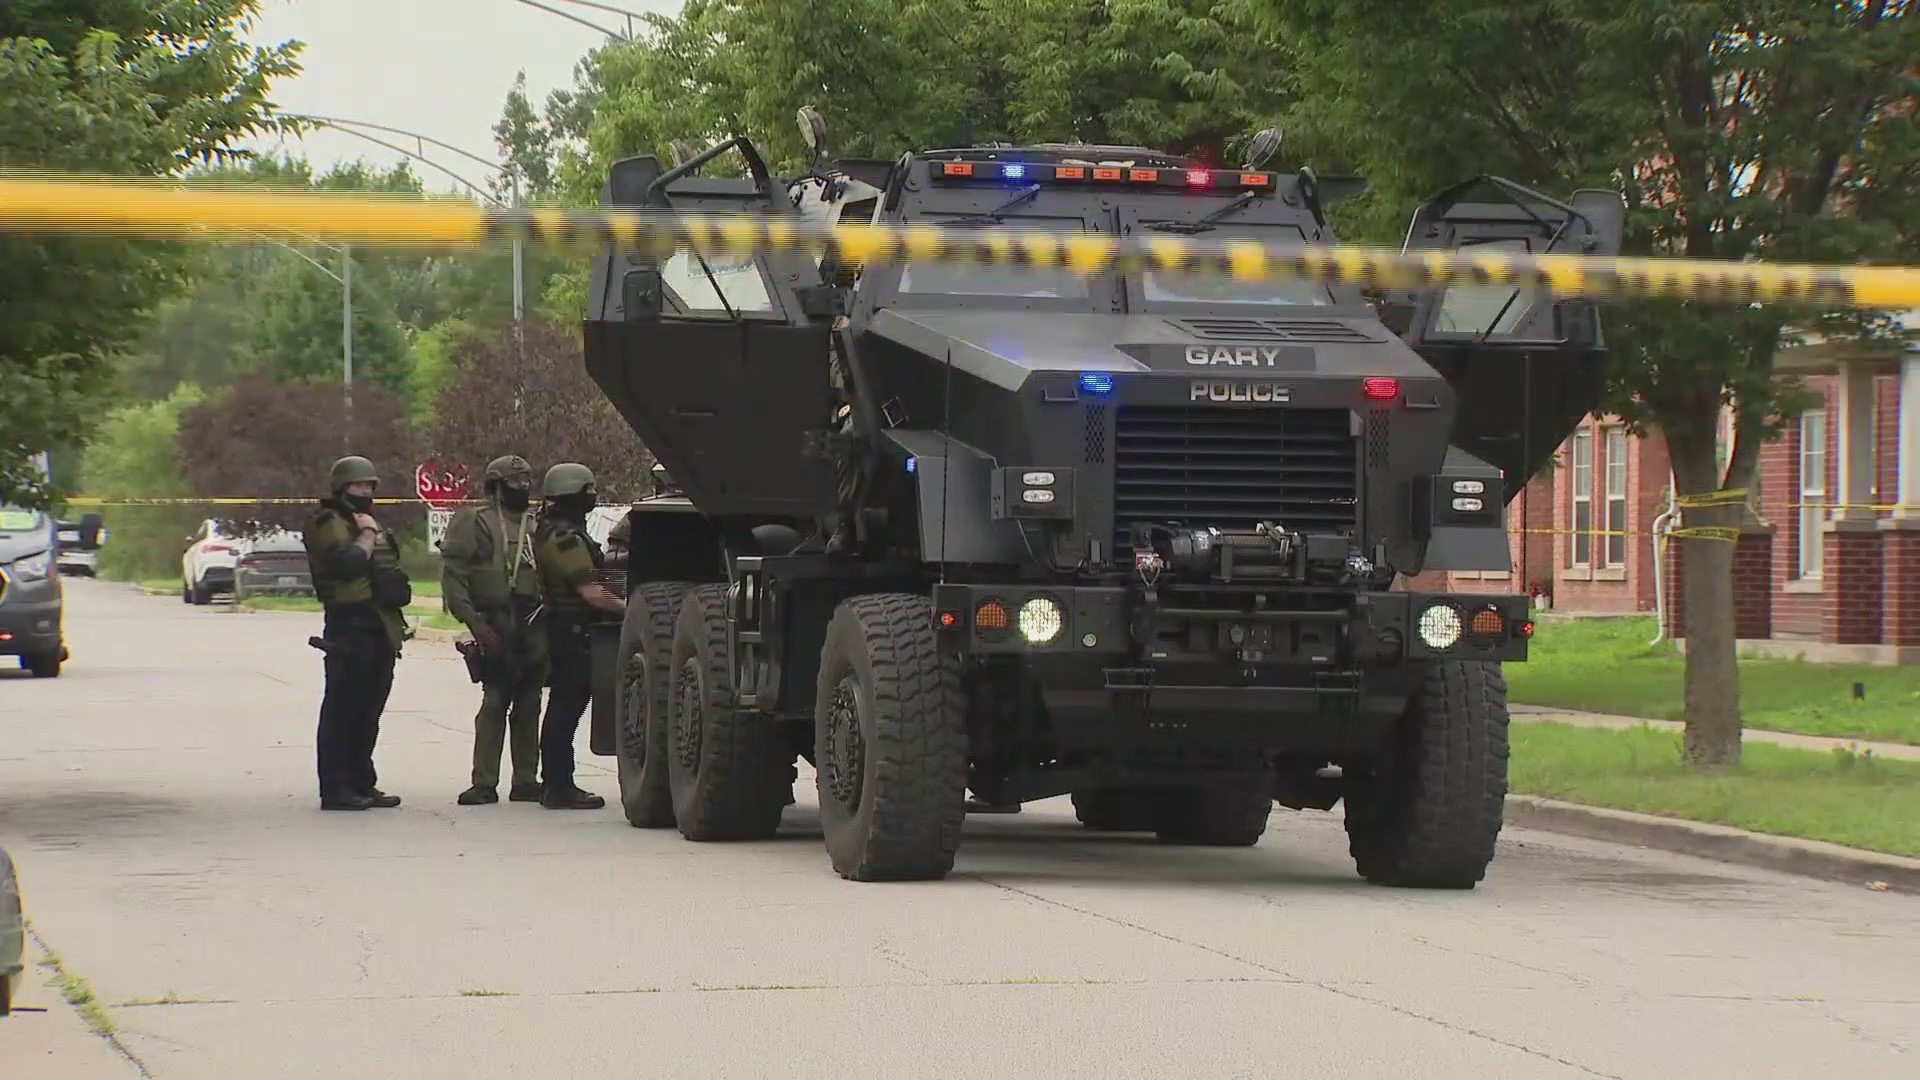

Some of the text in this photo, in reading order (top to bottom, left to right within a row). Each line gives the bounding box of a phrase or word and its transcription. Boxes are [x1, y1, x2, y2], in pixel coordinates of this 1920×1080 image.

[1185, 346, 1281, 366] GARY
[1190, 383, 1290, 402] POLICE
[431, 513, 453, 523] ON
[431, 526, 447, 536] WA
